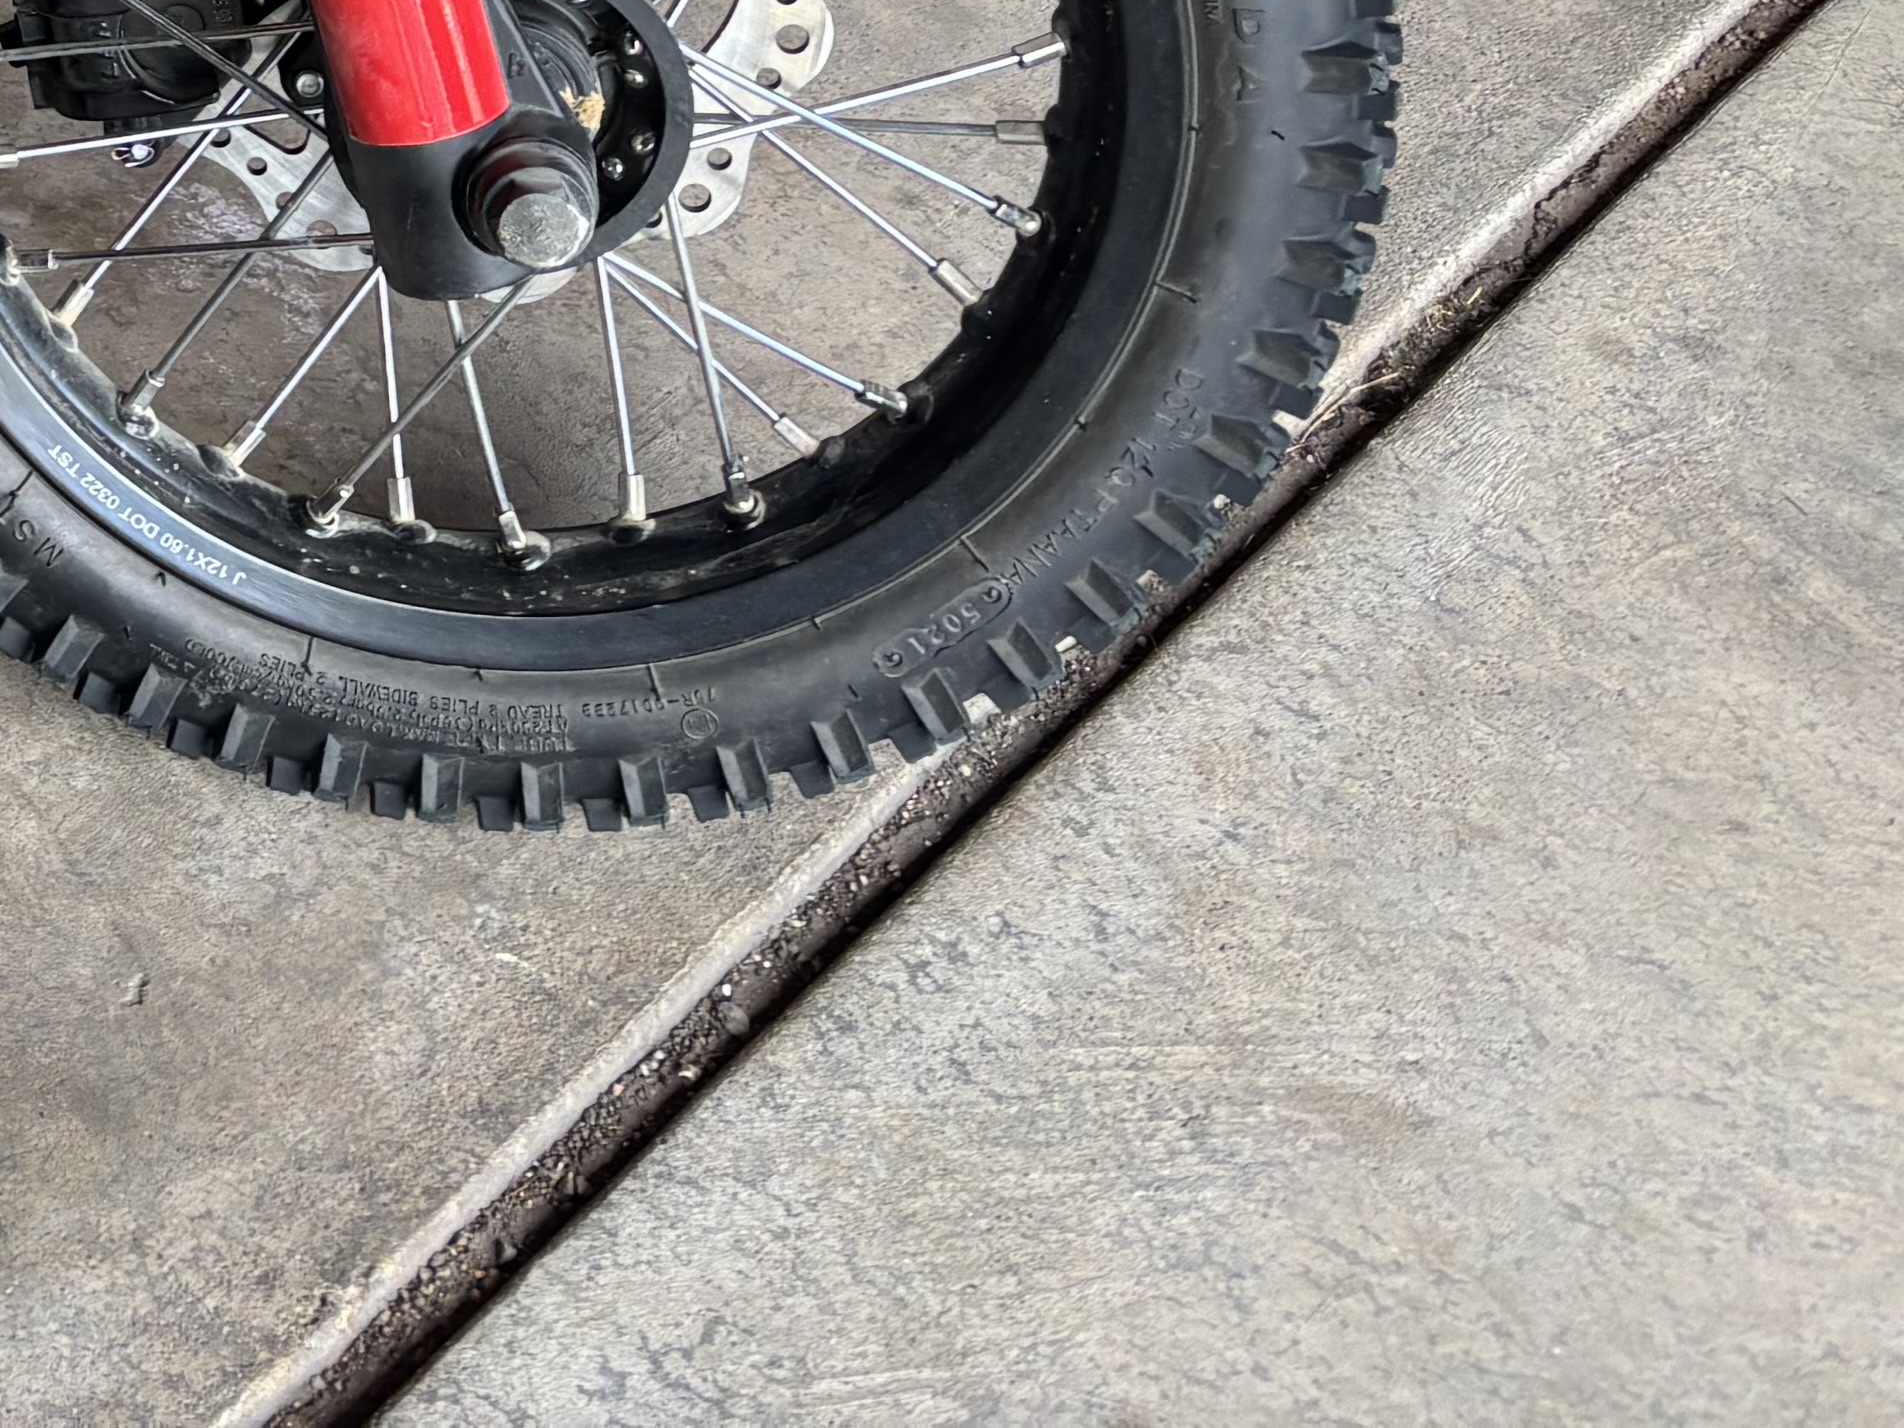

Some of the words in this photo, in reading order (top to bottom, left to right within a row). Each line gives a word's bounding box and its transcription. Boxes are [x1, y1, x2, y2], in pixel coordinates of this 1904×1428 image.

[1143, 361, 1212, 432] DOT
[42, 440, 86, 479] TST
[76, 471, 124, 511] 0322
[117, 503, 161, 539] DOT
[256, 652, 306, 683] PLIES
[314, 670, 326, 685] 2
[336, 675, 419, 707] SIDEWALL
[427, 695, 479, 716] PLIES
[506, 701, 562, 721] TREAD
